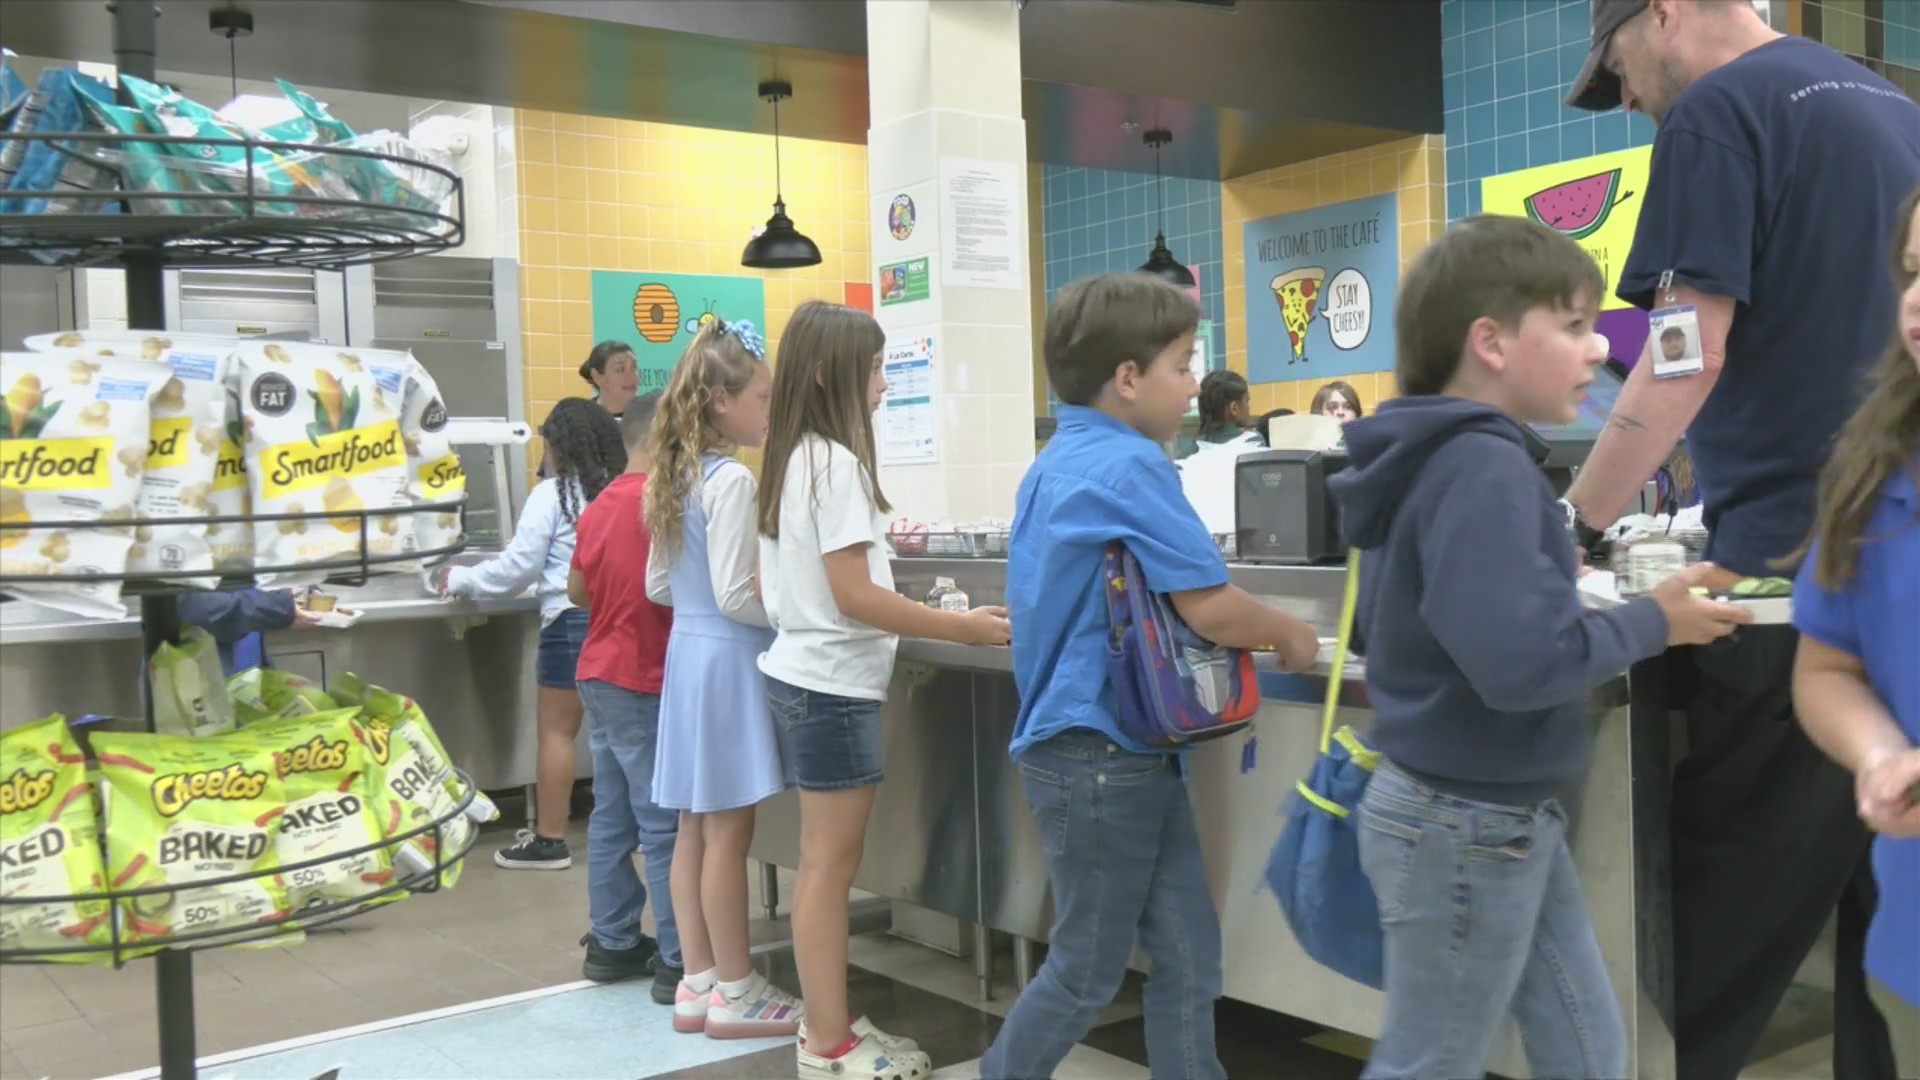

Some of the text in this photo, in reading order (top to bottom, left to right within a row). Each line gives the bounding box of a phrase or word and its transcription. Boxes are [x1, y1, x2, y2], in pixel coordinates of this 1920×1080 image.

[1790, 81, 1840, 101] serving
[1257, 211, 1380, 264] WELCOME TO THE CAFÉ
[908, 260, 926, 273] NEW
[1336, 283, 1359, 308] STAY
[1333, 310, 1365, 333] CHEESY!
[260, 392, 287, 407] FAT
[271, 429, 397, 487] Smartfood
[151, 762, 269, 818] Cheetos
[279, 794, 362, 834] AKED
[159, 830, 268, 866] BAKED
[292, 868, 326, 886] 50%
[184, 905, 220, 923] 50%
